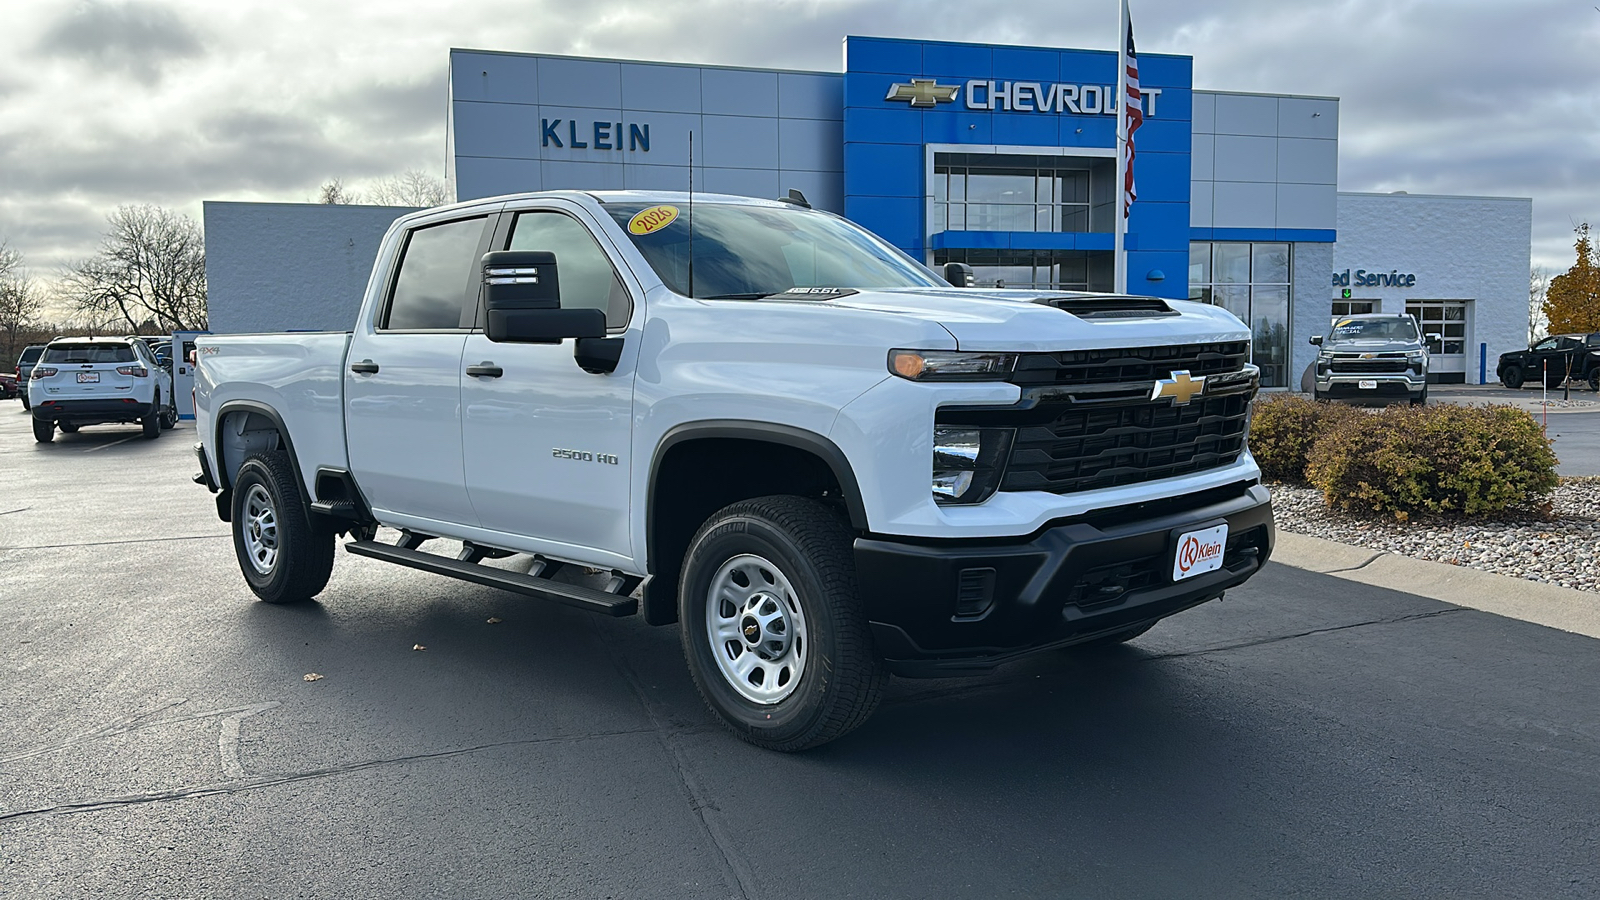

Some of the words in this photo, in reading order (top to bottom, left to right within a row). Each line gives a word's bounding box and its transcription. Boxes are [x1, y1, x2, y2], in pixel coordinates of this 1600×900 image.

[966, 79, 1162, 116] CHEVROLT
[541, 118, 650, 152] KLEIN
[636, 206, 672, 232] 2026
[1354, 269, 1416, 287] Service
[552, 447, 593, 462] 2500
[596, 452, 619, 465] HD
[701, 522, 745, 549] MICHELIN
[1198, 541, 1221, 559] Klein
